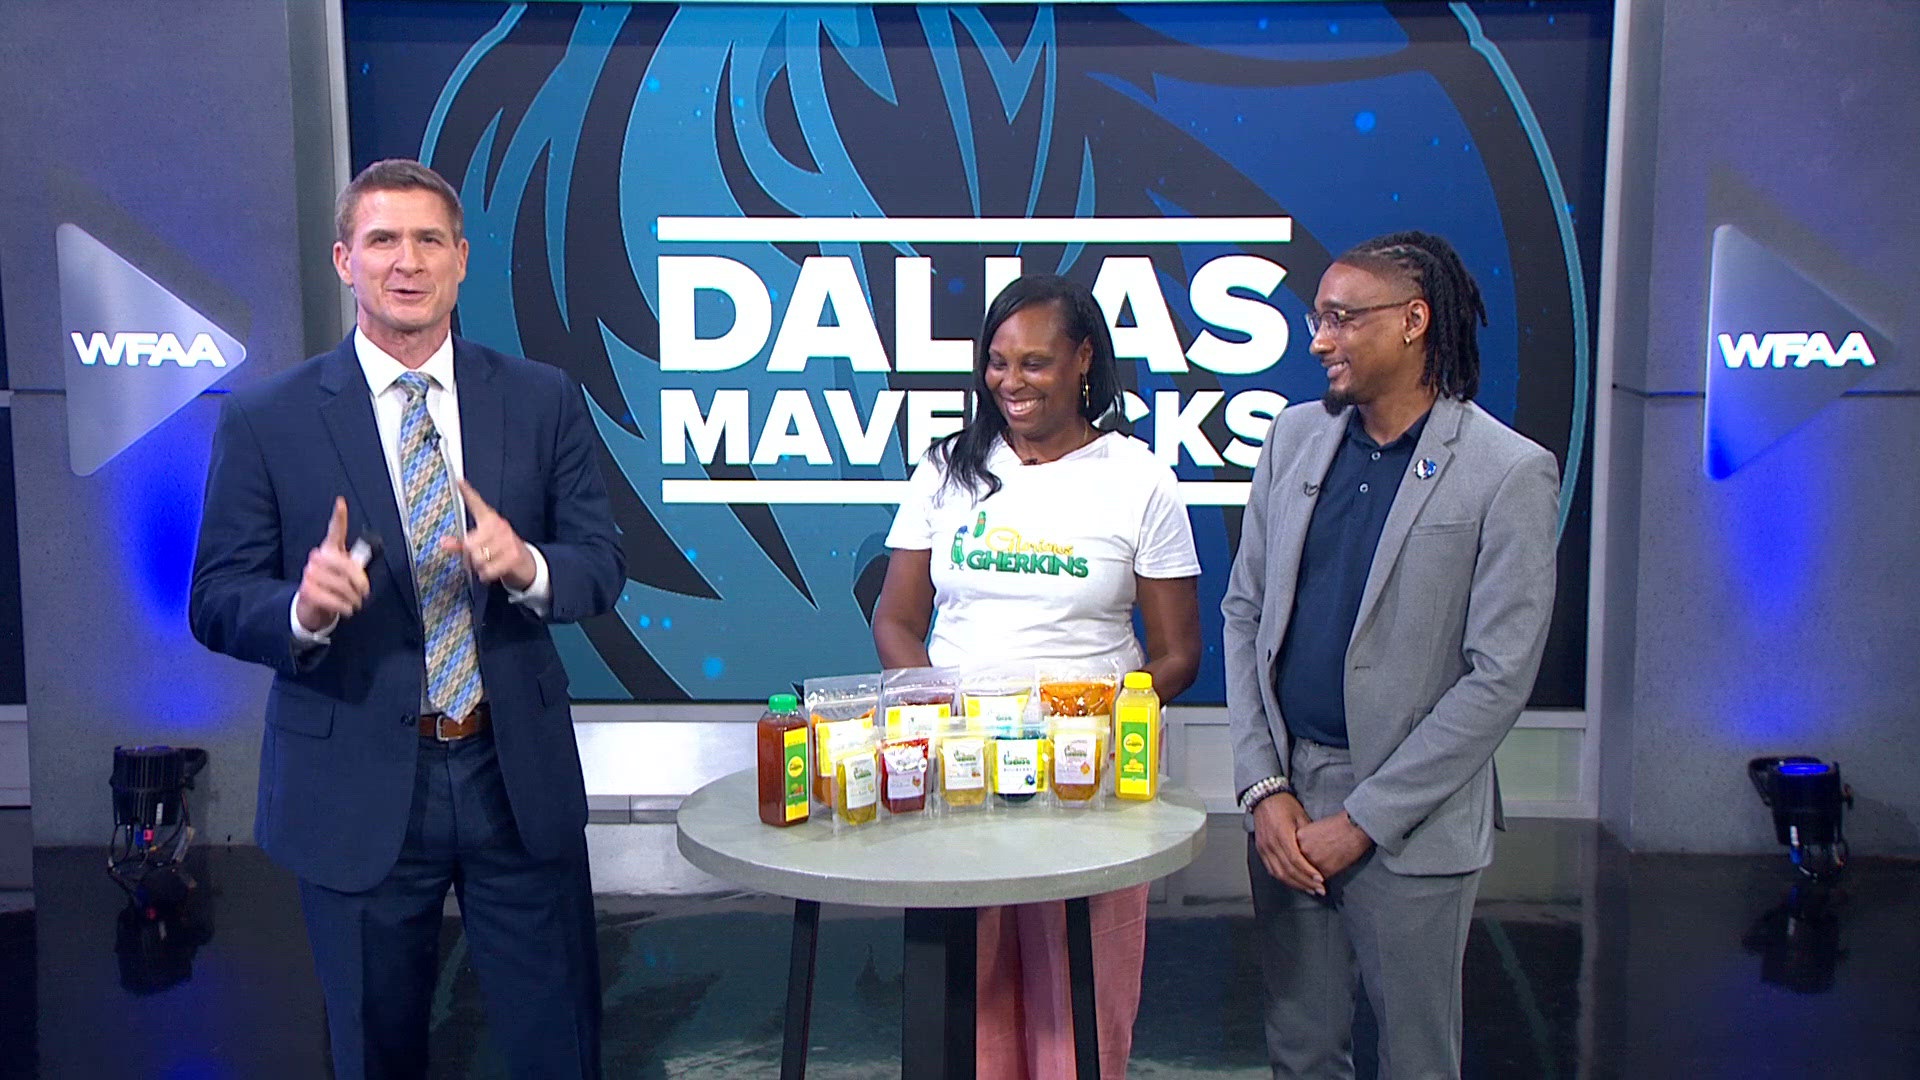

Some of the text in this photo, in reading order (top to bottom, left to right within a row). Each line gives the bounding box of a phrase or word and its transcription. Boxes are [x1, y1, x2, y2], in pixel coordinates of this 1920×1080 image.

[71, 332, 227, 367] WFAA
[1717, 331, 1877, 368] WFAA
[660, 389, 1289, 468] MAVEKS
[985, 526, 1074, 555] Glorious
[966, 549, 1089, 578] GHERKINS
